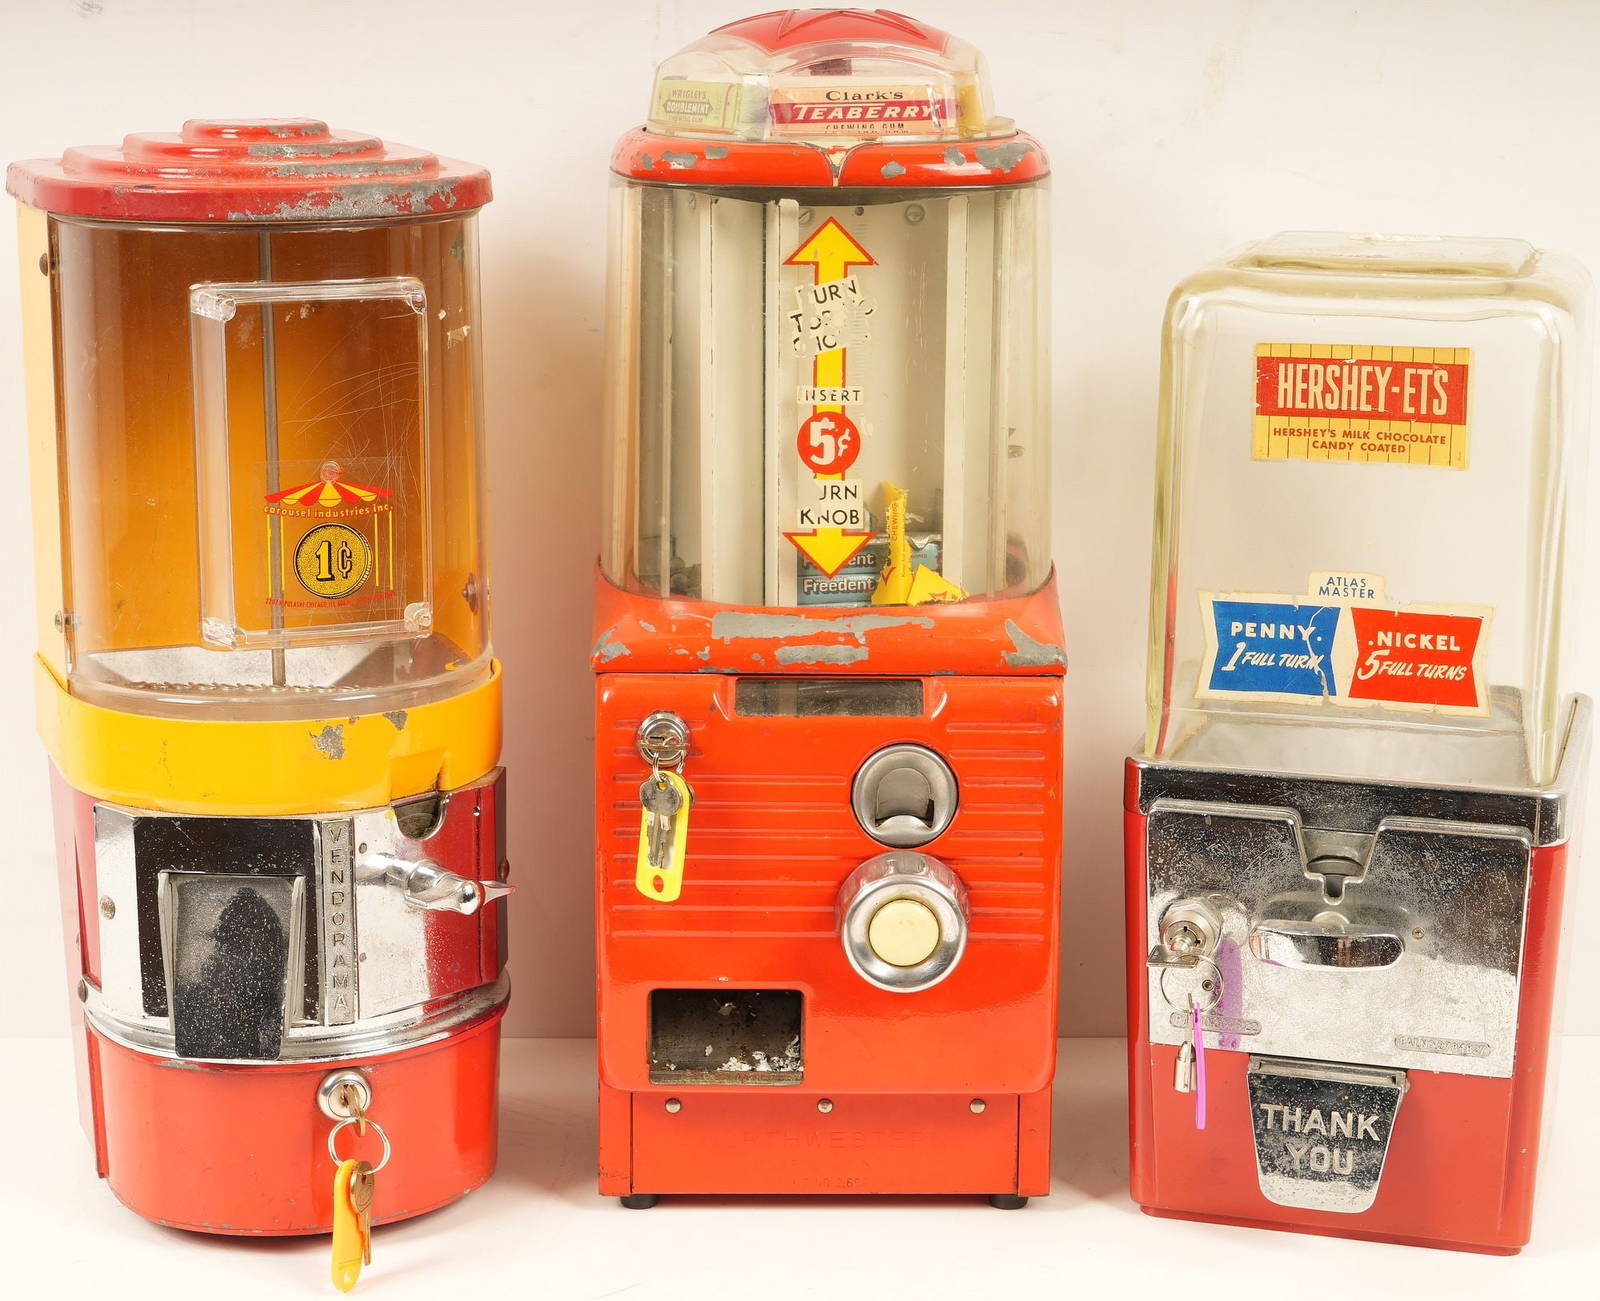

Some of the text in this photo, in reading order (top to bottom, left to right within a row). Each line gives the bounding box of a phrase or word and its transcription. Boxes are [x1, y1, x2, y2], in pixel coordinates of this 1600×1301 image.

[825, 90, 904, 101] Clark's
[793, 103, 941, 121] TEABERRY
[1277, 362, 1449, 416] HERSHEY-ETS
[1273, 427, 1447, 445] HERSHEY'S MILK CHOCOLATE
[1312, 440, 1407, 453] CANDY COATED
[263, 505, 311, 517] carousel
[315, 507, 370, 518] industries
[800, 509, 860, 525] KNOB
[803, 577, 875, 594] Freedent
[1326, 576, 1367, 588] ATLAS
[1318, 586, 1376, 600] MASTER
[1221, 641, 1247, 672] 1
[1241, 651, 1278, 667] FULL
[1357, 649, 1468, 682] 5 FULL TURNS
[327, 826, 349, 1011] VENDORAMA
[1259, 1102, 1381, 1142] THANK
[1285, 1142, 1354, 1176] YOU
